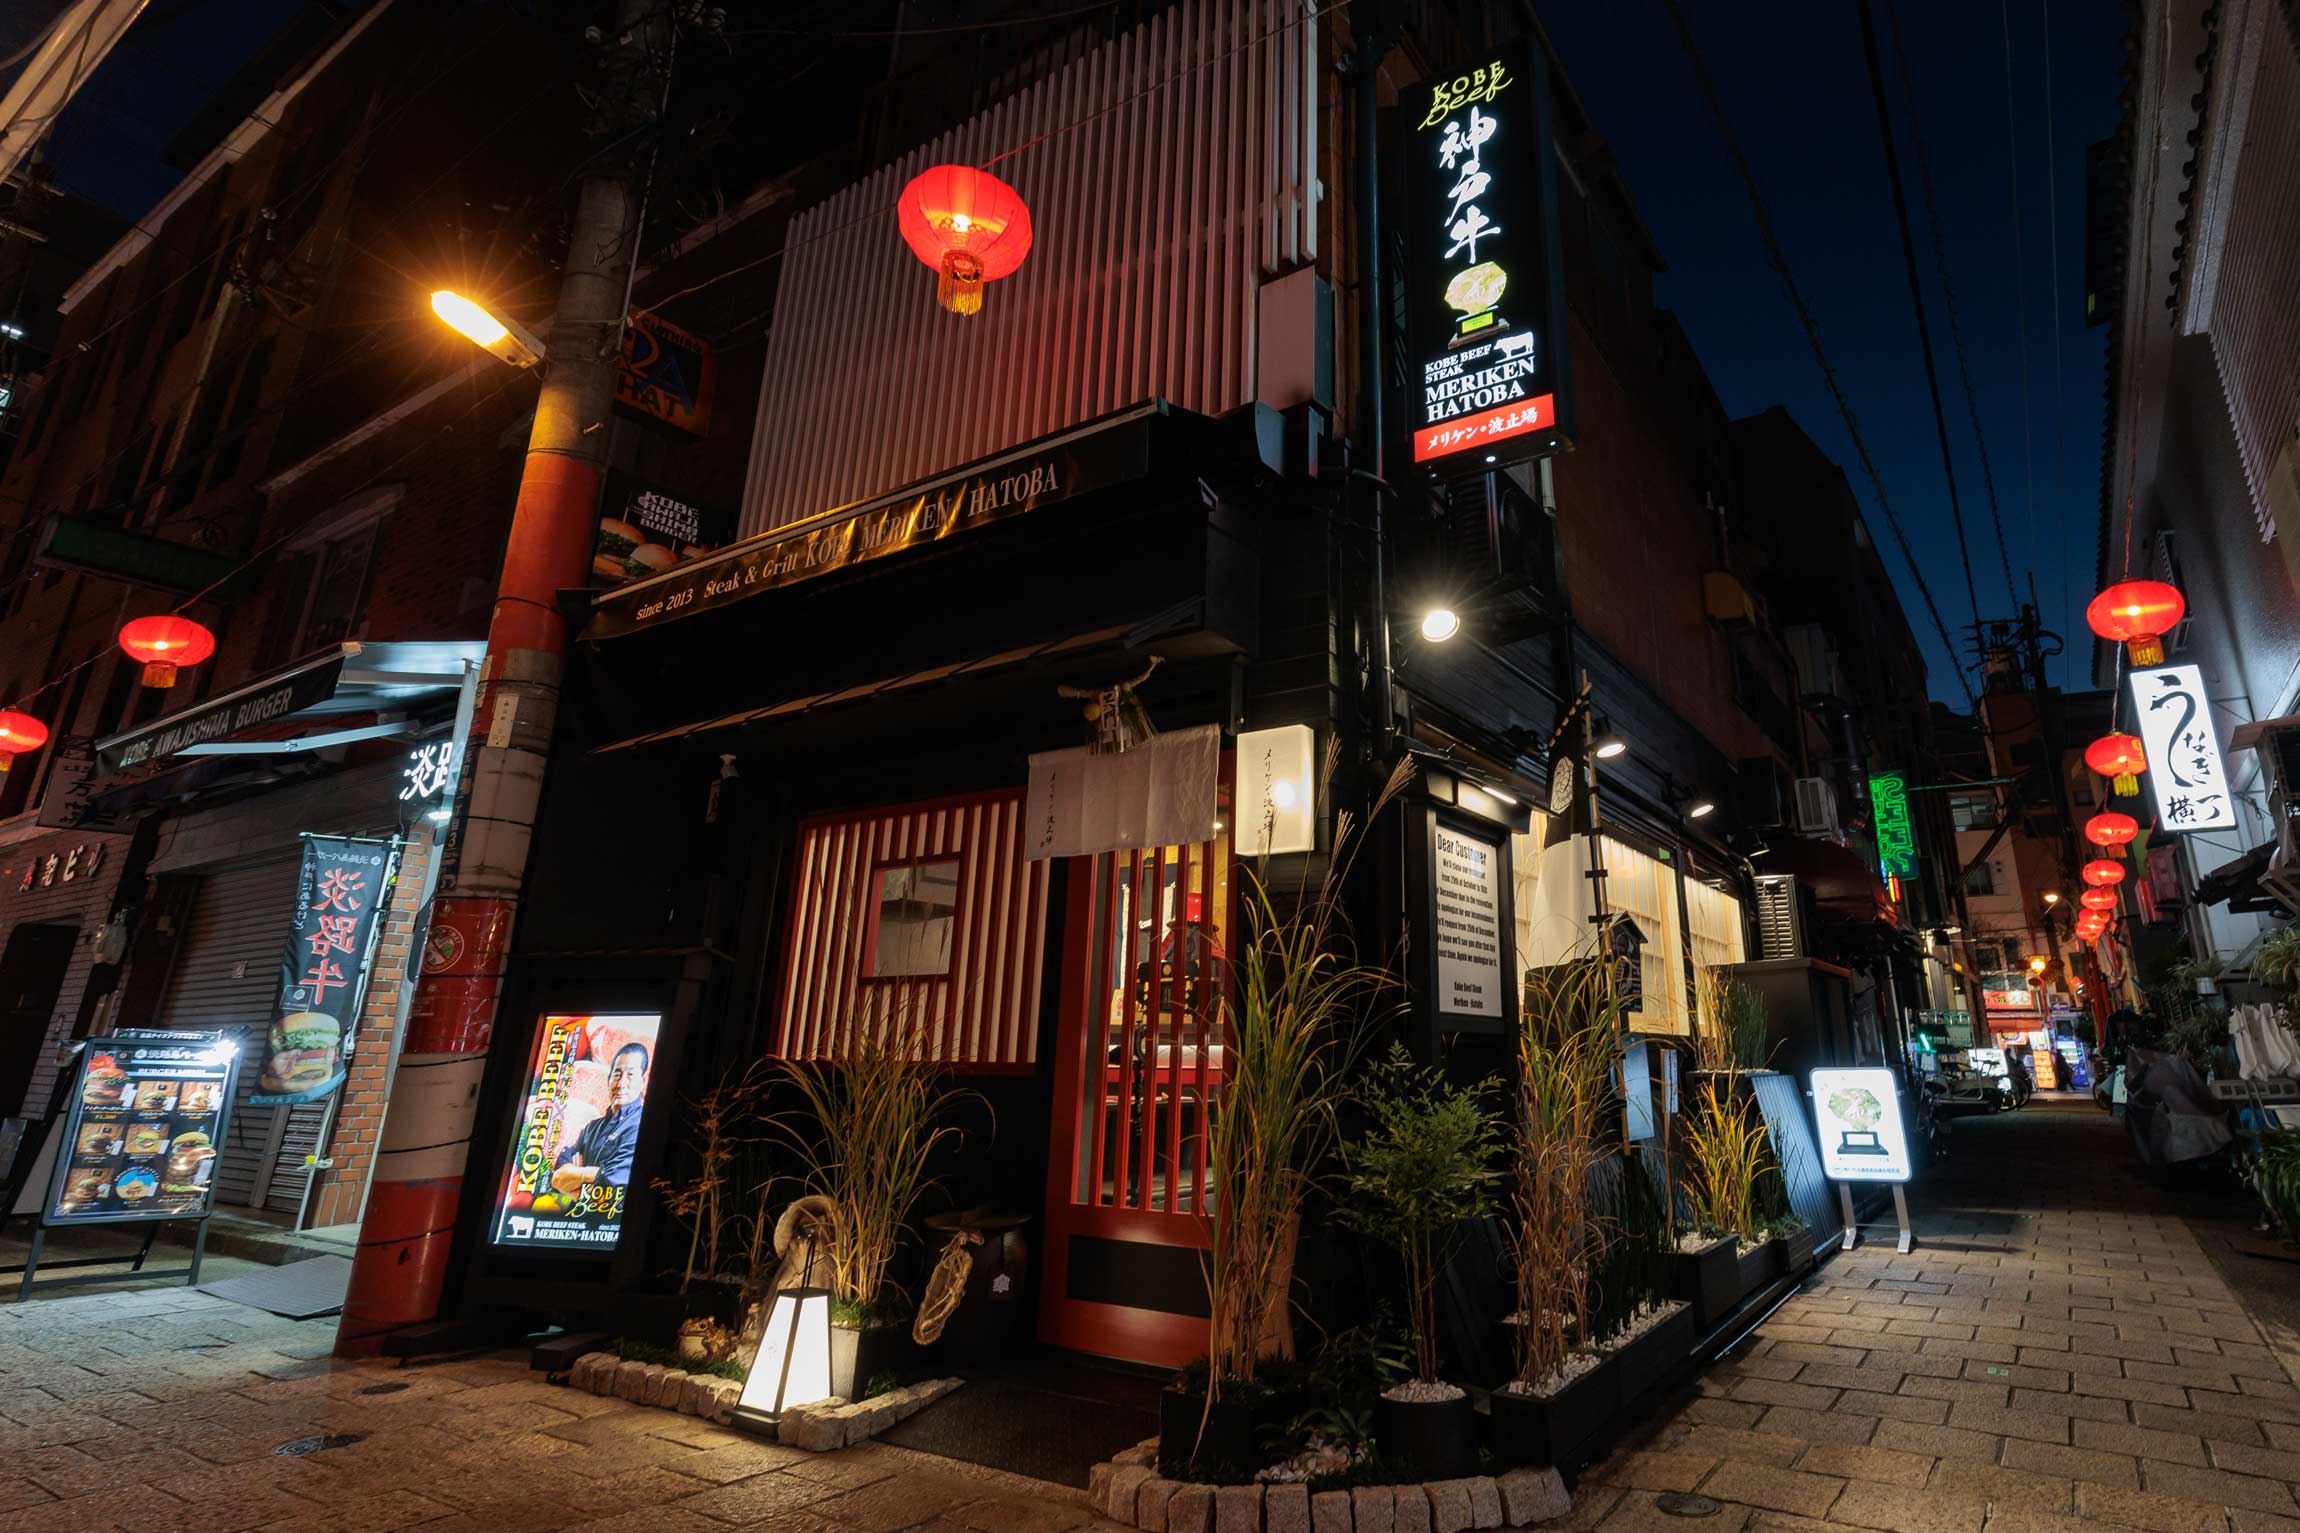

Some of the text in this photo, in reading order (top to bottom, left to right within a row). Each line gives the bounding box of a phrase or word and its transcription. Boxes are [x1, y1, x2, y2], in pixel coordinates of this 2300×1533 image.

[1418, 66, 1513, 131] Beef
[1432, 60, 1503, 104] KOBE
[1439, 105, 1501, 264] 神戸牛
[1424, 343, 1492, 375] KOBE BEEF
[1424, 364, 1463, 385] STEAK
[1425, 356, 1535, 404] MERIKEN
[1427, 380, 1525, 423] HATOBA
[645, 491, 699, 517] KOBE
[640, 519, 697, 543] BURGER
[642, 510, 698, 536] SHIMA
[636, 601, 664, 621] since
[666, 588, 694, 611] 2013
[704, 573, 740, 599] Steak
[744, 566, 760, 585] &
[763, 553, 798, 578] Grill
[804, 534, 850, 569] KOB
[967, 463, 1060, 517] HATOBA
[235, 687, 294, 729] BURGER
[2149, 674, 2215, 788] うなぎ
[1437, 833, 1453, 854] Dear
[517, 1106, 552, 1194] KOBE
[537, 1023, 570, 1102] BEEF
[565, 1194, 624, 1219] Beef
[581, 1184, 624, 1200] KOBE
[536, 1220, 552, 1228] KOBE
[553, 1221, 568, 1229] BEEF
[568, 1222, 586, 1230] STEAK
